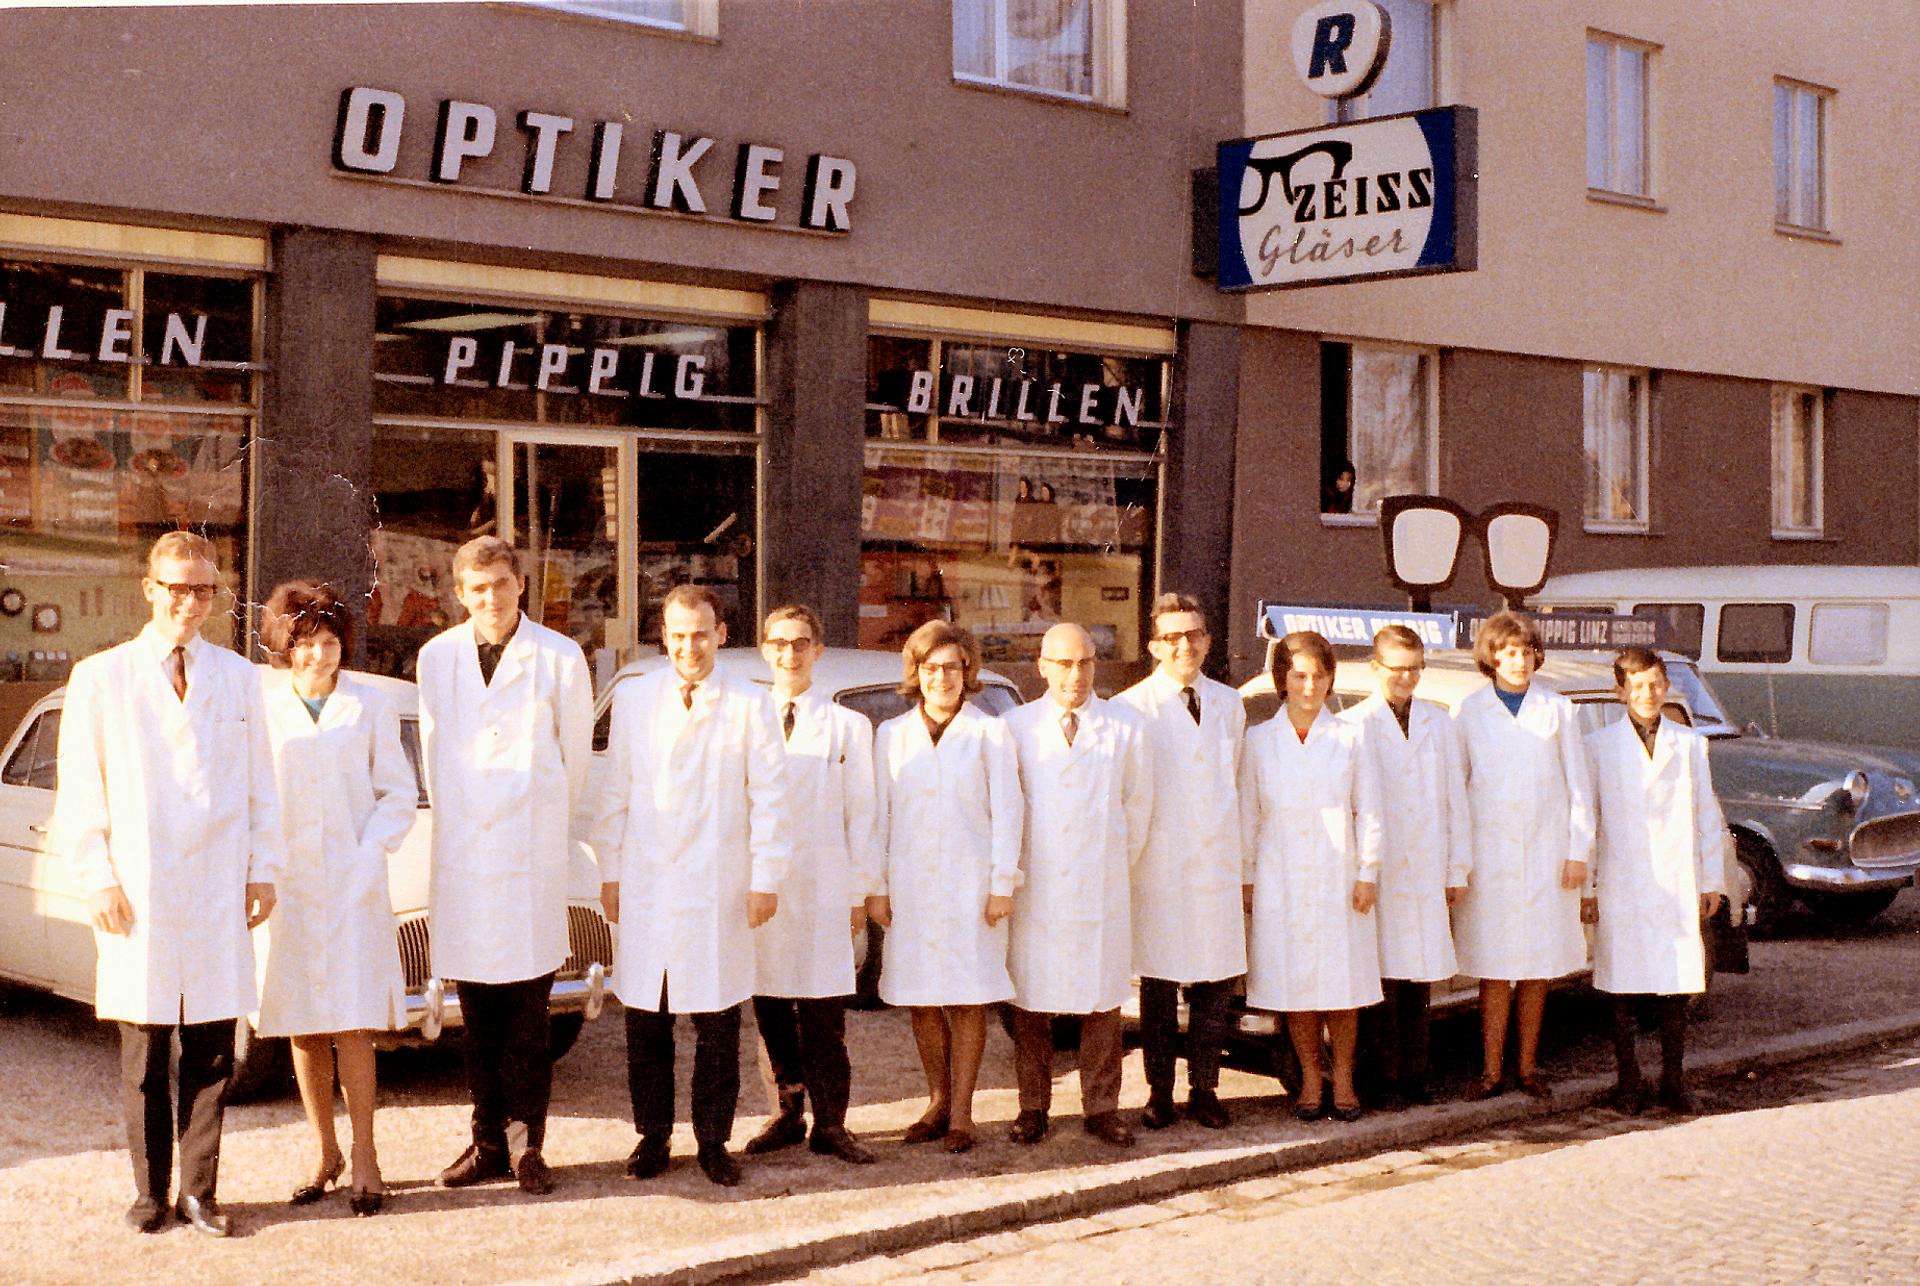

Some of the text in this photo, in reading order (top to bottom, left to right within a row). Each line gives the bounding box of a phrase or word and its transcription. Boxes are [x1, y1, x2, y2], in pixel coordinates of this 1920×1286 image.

[1308, 13, 1355, 79] R
[338, 87, 856, 231] OPTIKER
[1294, 167, 1432, 223] ZEISS
[1259, 225, 1408, 277] Gläser
[444, 337, 706, 399] PIPPIG
[907, 371, 1143, 426] BRILLEN
[1580, 620, 1608, 644] LINZ
